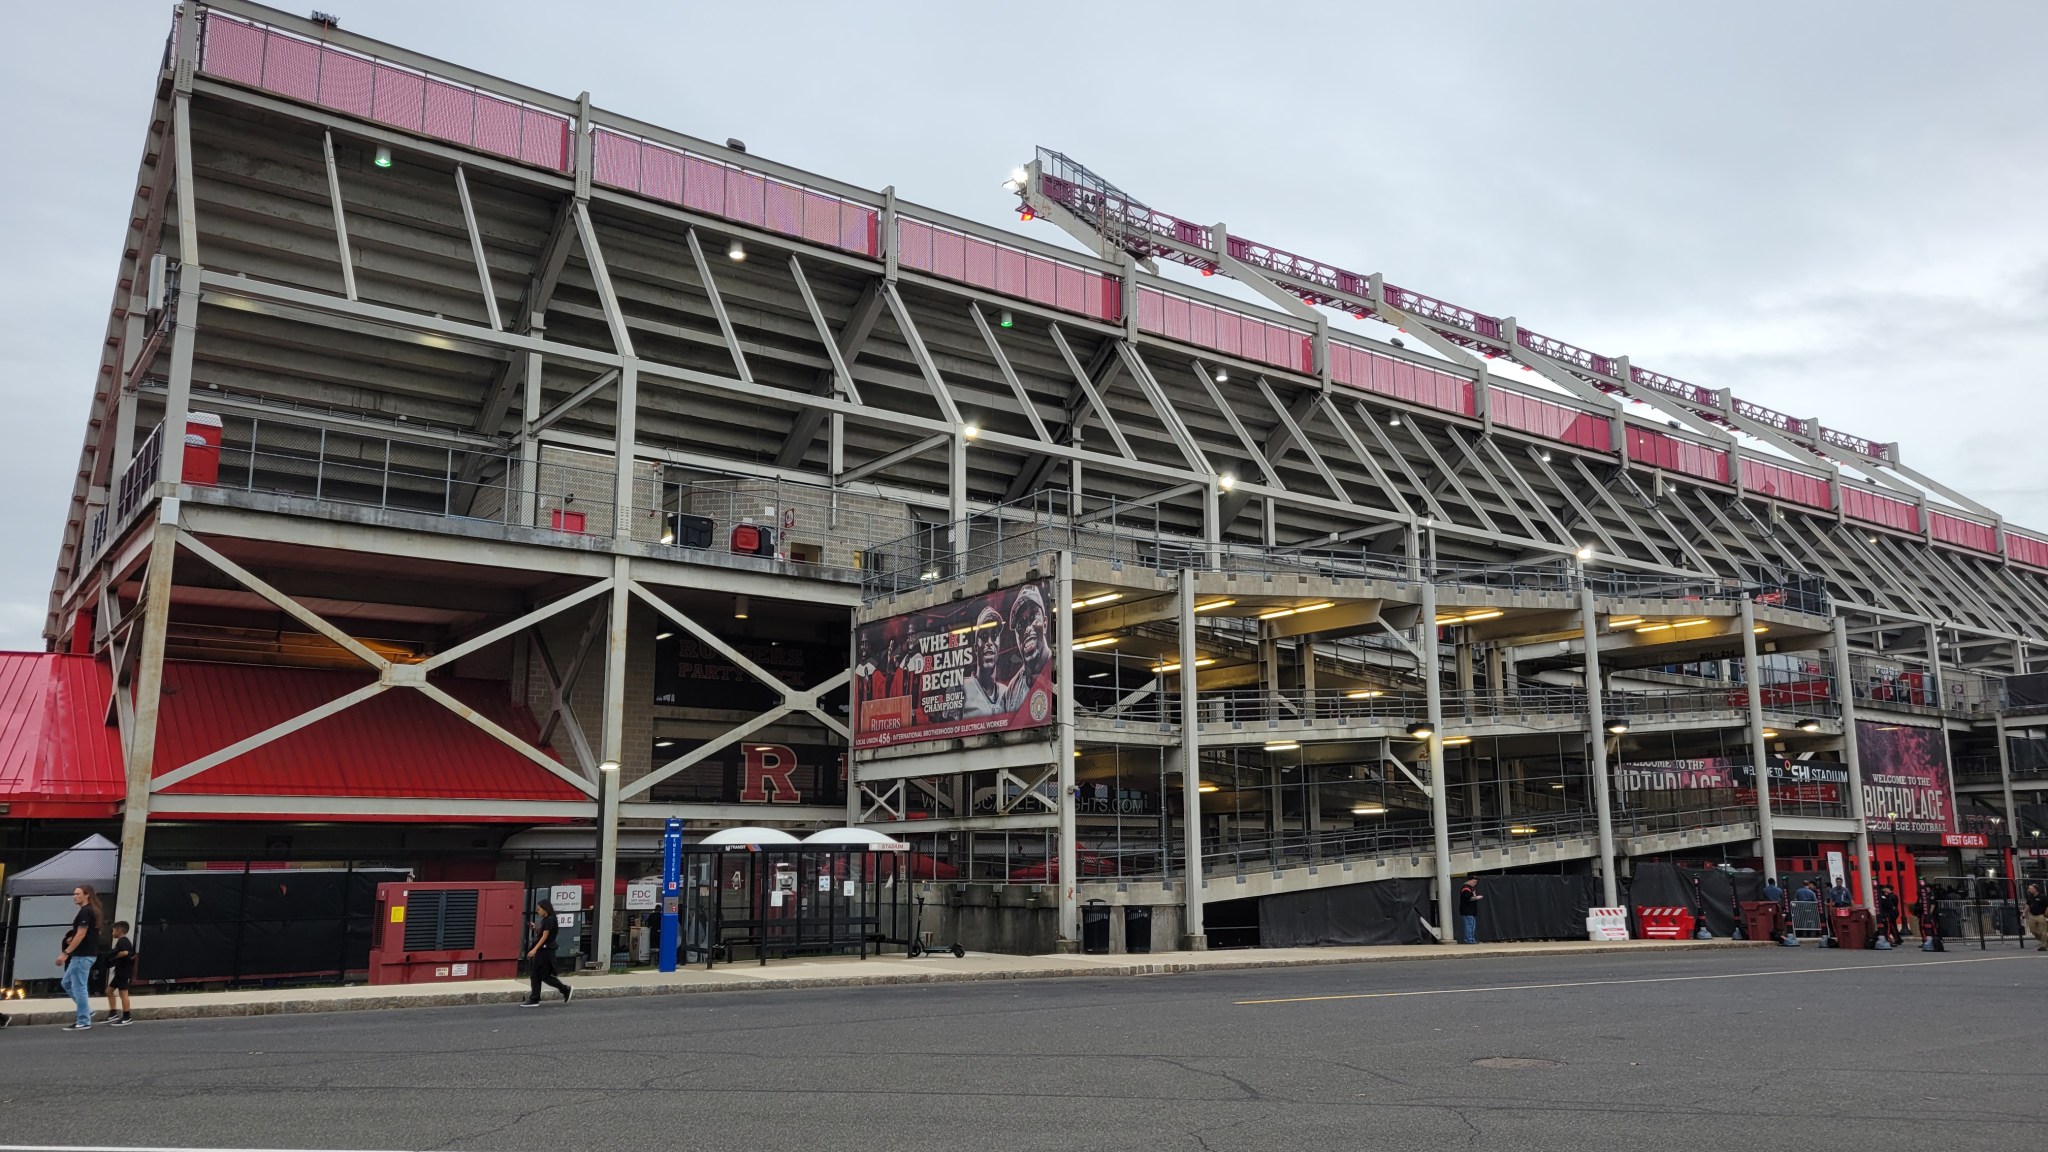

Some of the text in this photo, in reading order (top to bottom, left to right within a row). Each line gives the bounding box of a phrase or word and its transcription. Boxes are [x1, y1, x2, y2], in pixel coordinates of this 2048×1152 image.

[919, 632, 969, 654] WHERE
[915, 647, 973, 675] DREAMS
[922, 668, 965, 692] BEGIN
[922, 692, 965, 706] SUPER BOWL
[924, 700, 963, 713] CHAMPIONS
[871, 718, 901, 731] RUTGERS
[879, 733, 891, 744] 456
[892, 732, 922, 741] INTERNATIONAL
[924, 726, 954, 737] BROTHERHOOD
[954, 726, 960, 734] OF
[961, 722, 986, 732] ELECTRICAL
[986, 720, 1008, 729] WORKERS
[1686, 760, 1706, 770] THE
[740, 742, 801, 803] R
[1775, 767, 1783, 776] TO
[1792, 765, 1810, 782] SHI
[1812, 768, 1848, 783] STADIUM
[1872, 774, 1931, 786] WELCOME TO THE
[1862, 785, 1946, 820] BIRTHPLACE
[1878, 822, 1912, 831] COLEGE
[1912, 822, 1948, 832] FOOTBALL
[1946, 835, 1984, 846] WEST GATE A
[556, 892, 576, 900] FDC
[632, 890, 651, 898] FDC
